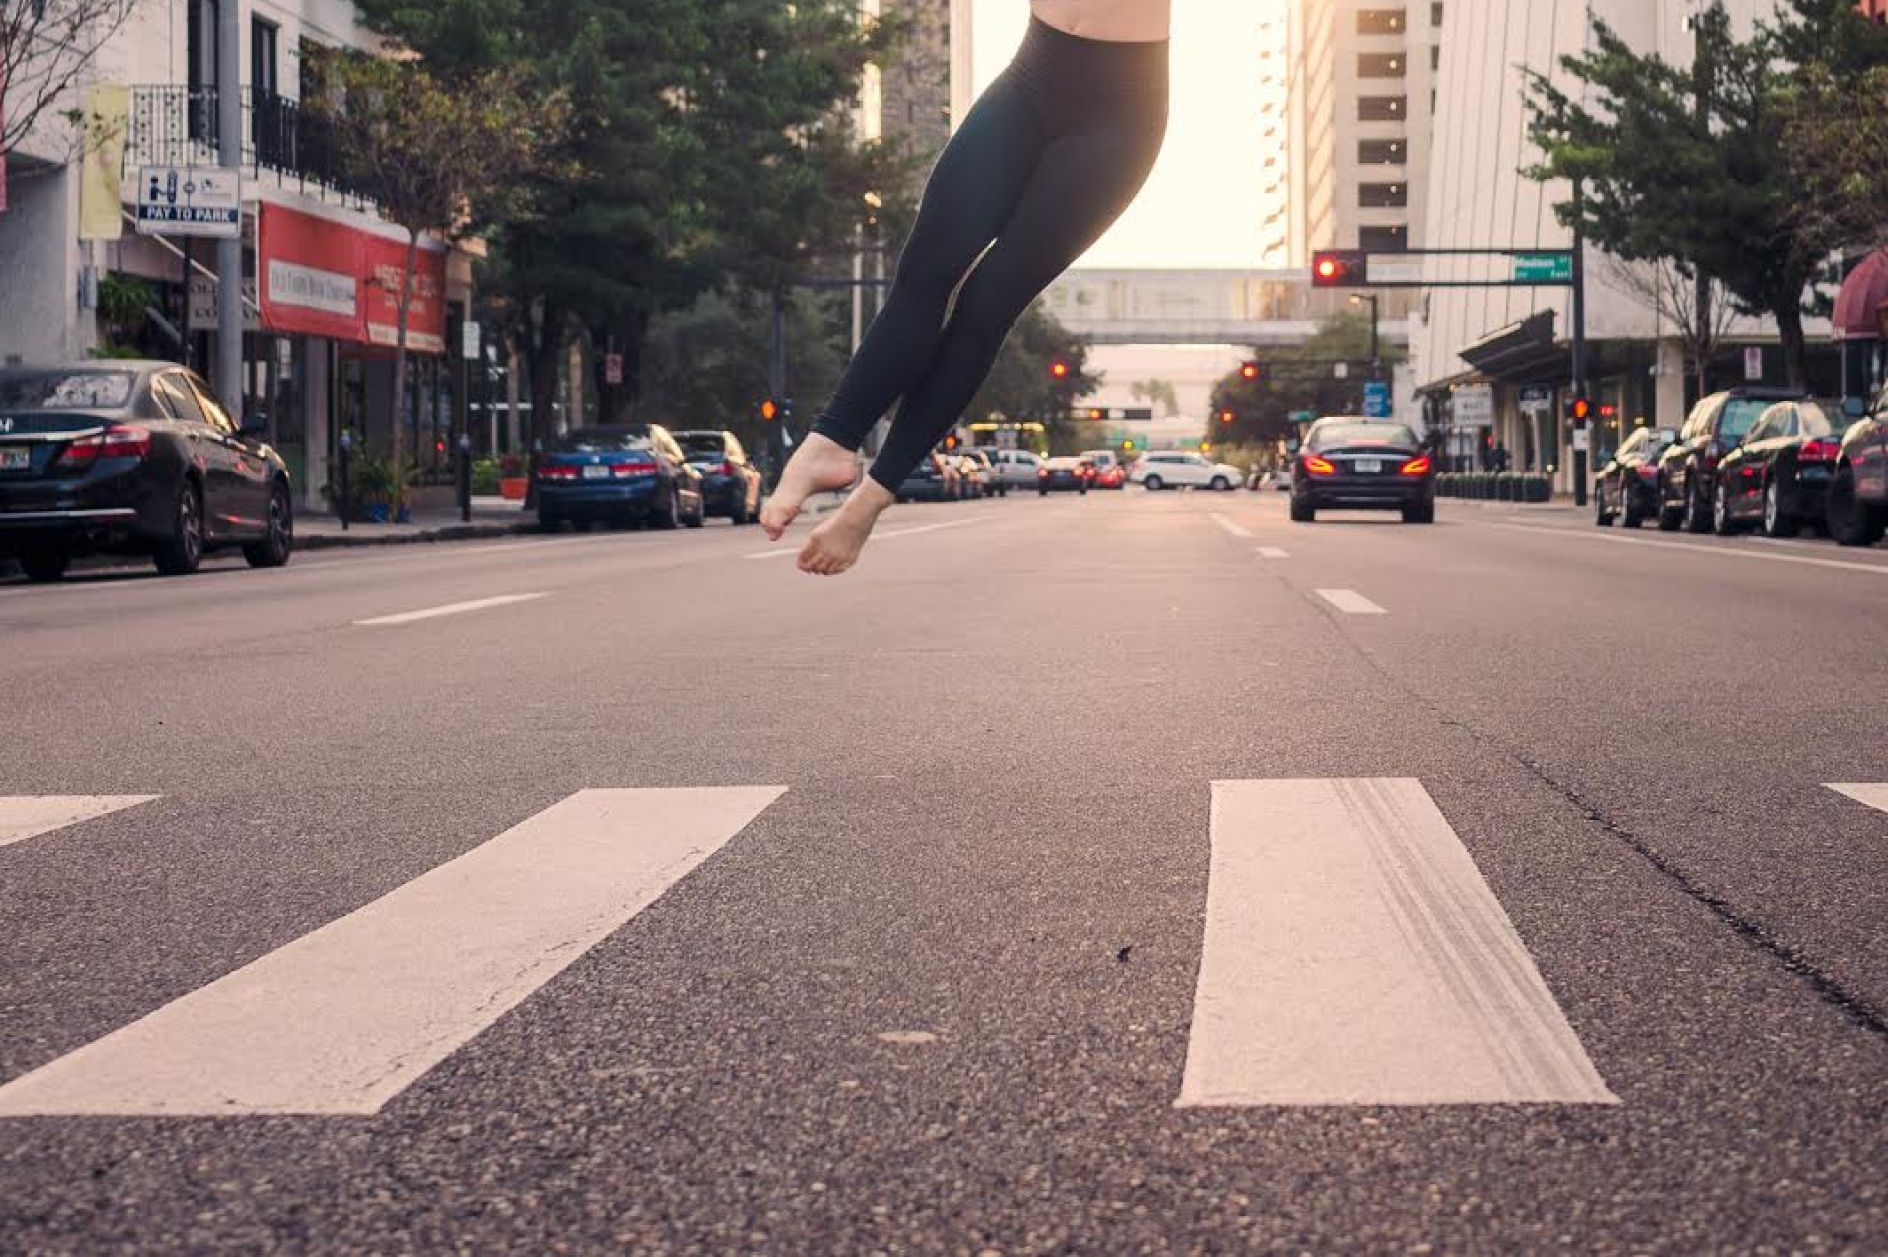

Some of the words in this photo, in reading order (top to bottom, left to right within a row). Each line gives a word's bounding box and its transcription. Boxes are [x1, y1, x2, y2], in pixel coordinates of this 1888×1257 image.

[147, 206, 172, 220] PAY
[175, 207, 193, 221] TO
[195, 207, 230, 222] PARK
